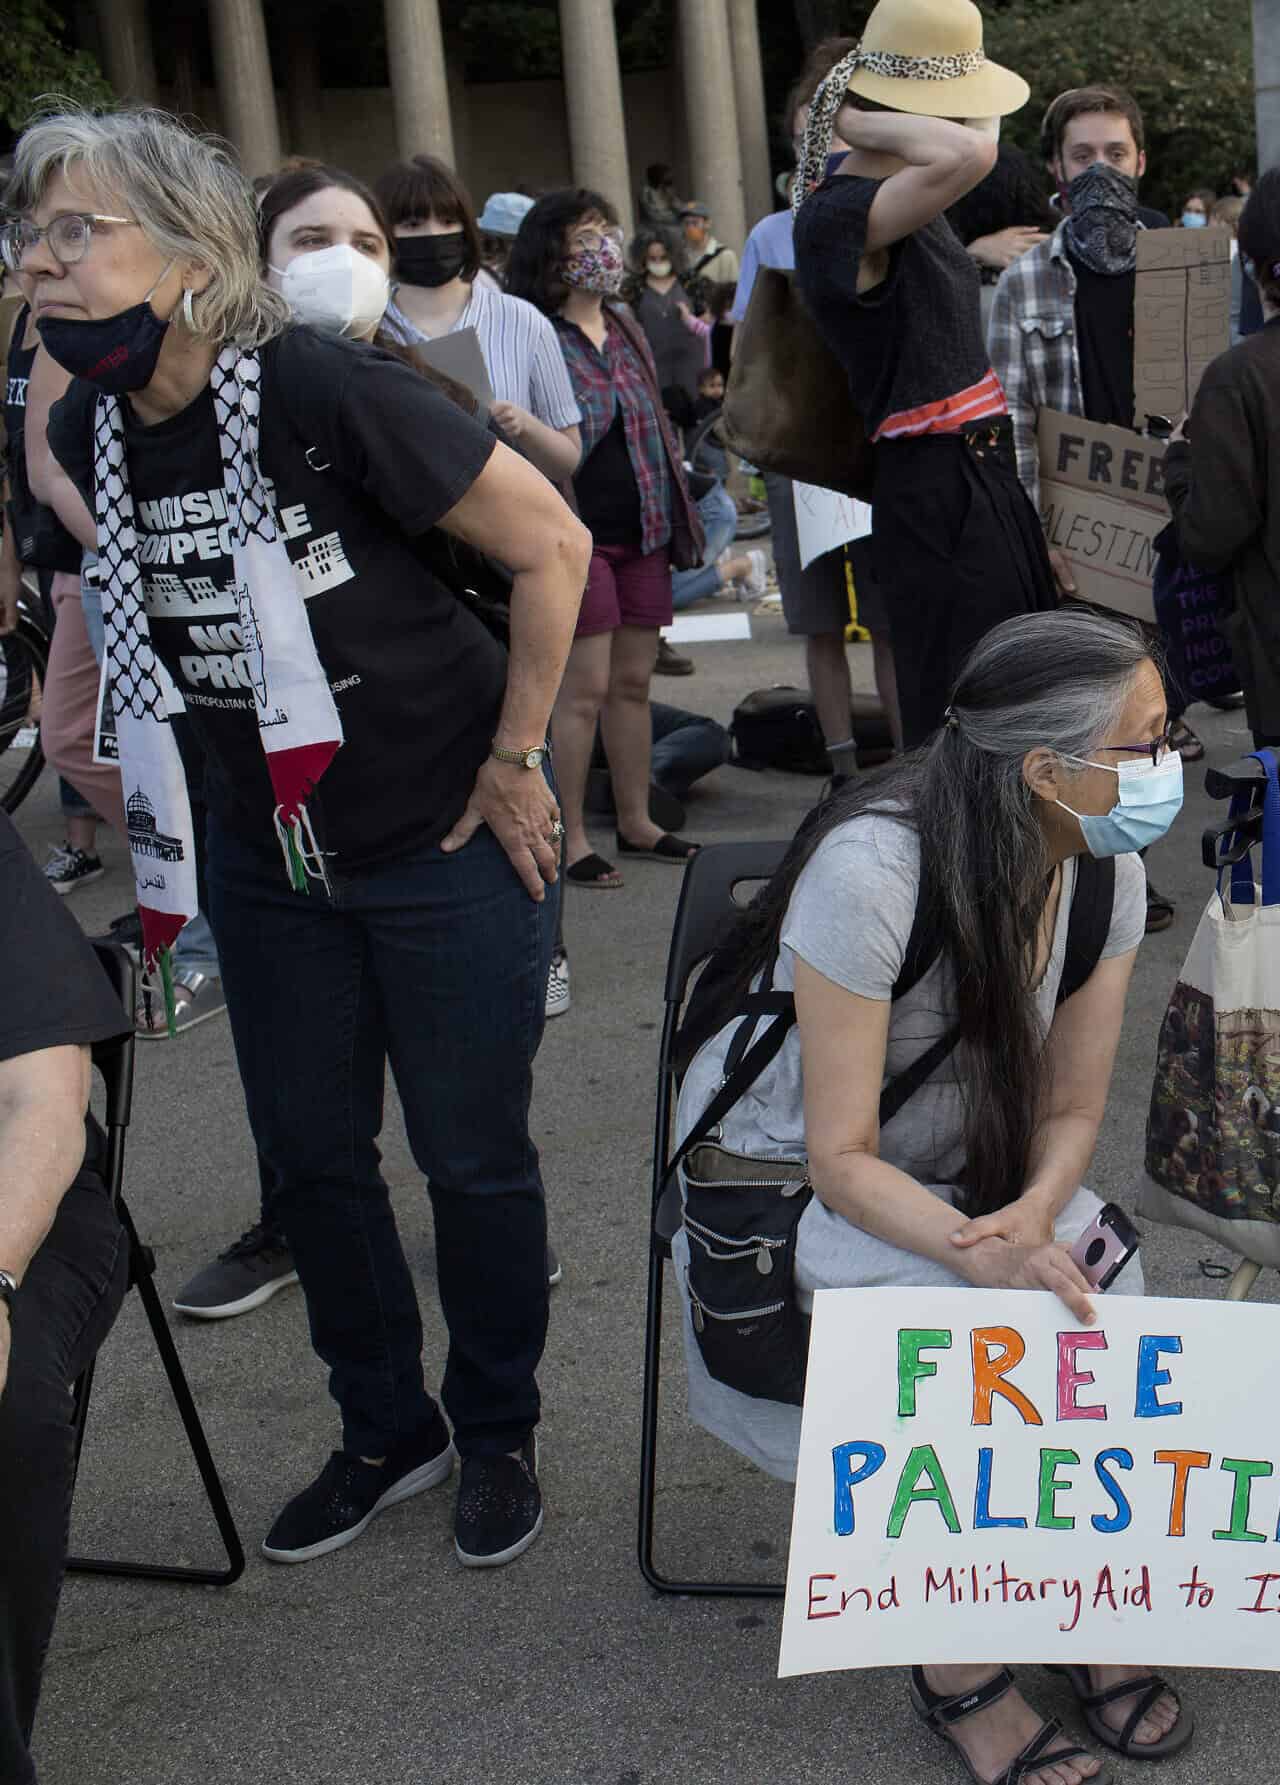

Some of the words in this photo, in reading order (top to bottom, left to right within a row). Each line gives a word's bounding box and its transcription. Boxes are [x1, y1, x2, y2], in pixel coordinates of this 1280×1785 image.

[1057, 433, 1166, 497] FREE
[187, 622, 245, 652] NO
[179, 652, 254, 689] PRO
[898, 1325, 1184, 1425] FREE
[807, 1572, 900, 1620] End
[924, 1563, 1081, 1632] Military
[1092, 1565, 1153, 1612] Aid
[1179, 1565, 1214, 1608] to
